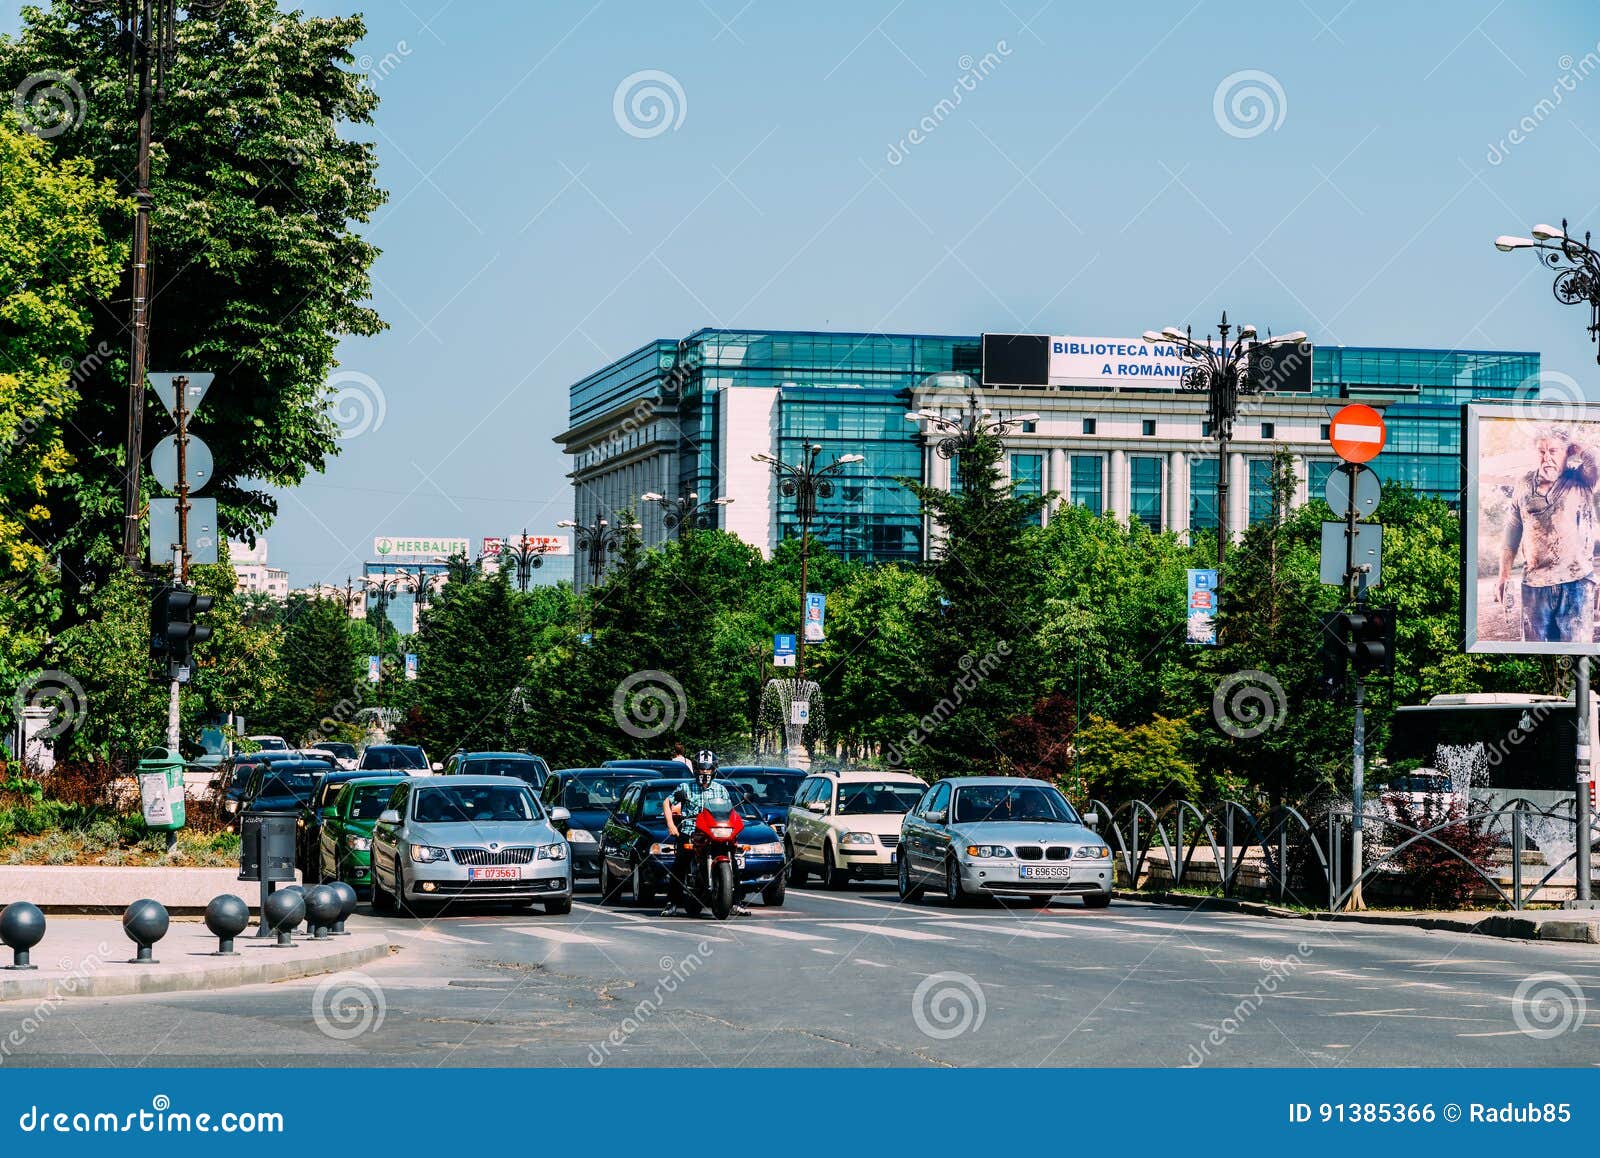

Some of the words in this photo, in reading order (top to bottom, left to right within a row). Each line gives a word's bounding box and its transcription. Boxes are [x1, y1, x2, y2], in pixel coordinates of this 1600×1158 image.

[1053, 342, 1148, 357] BIBLIOTECA
[1101, 363, 1113, 375] A
[521, 536, 558, 546] STRA
